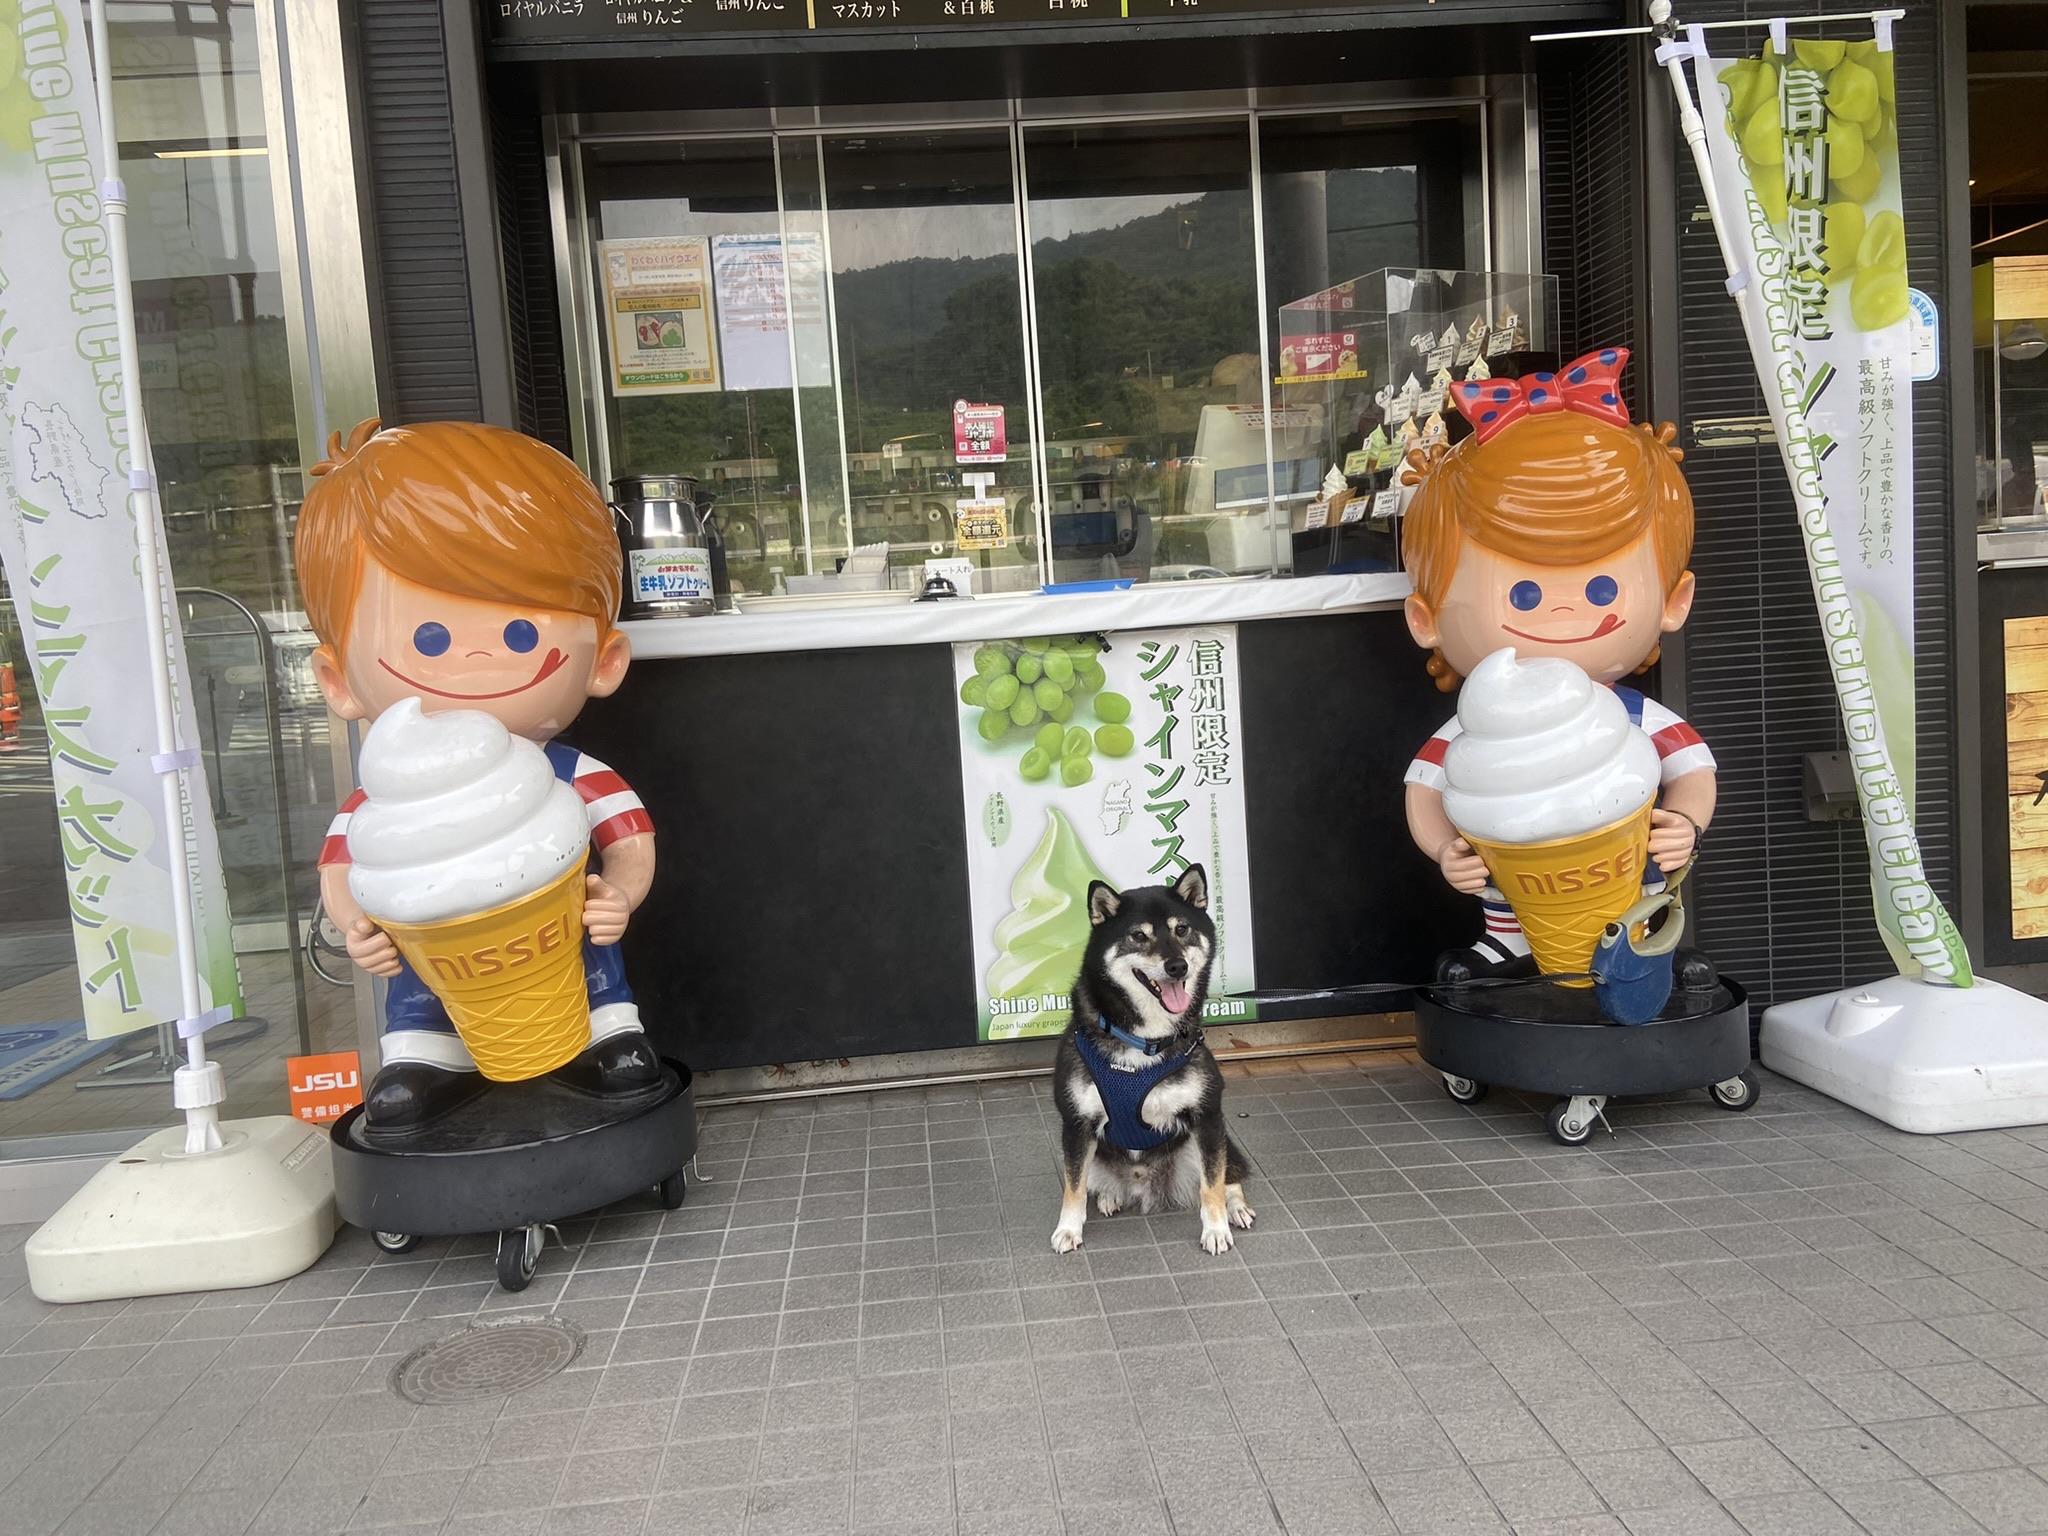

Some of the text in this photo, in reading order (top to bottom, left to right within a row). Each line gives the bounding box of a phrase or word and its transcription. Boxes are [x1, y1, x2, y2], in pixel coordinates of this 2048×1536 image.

[500, 1, 585, 18] ロイヤルバニラ
[832, 1, 901, 18] マスカット
[1858, 359, 1875, 570] 最高級ソフトクリームです。
[1187, 640, 1231, 786] 信州限定
[1137, 640, 1190, 888] シャインマス
[1515, 842, 1640, 895] NISSEI
[428, 912, 570, 981] NISSEI
[989, 997, 1038, 1015] Shine
[1201, 1000, 1246, 1017] ream
[992, 1022, 1015, 1031] Japan
[1016, 1020, 1041, 1030] luxury
[1110, 1064, 1136, 1073] VOYAGER
[292, 1071, 358, 1092] JSU
